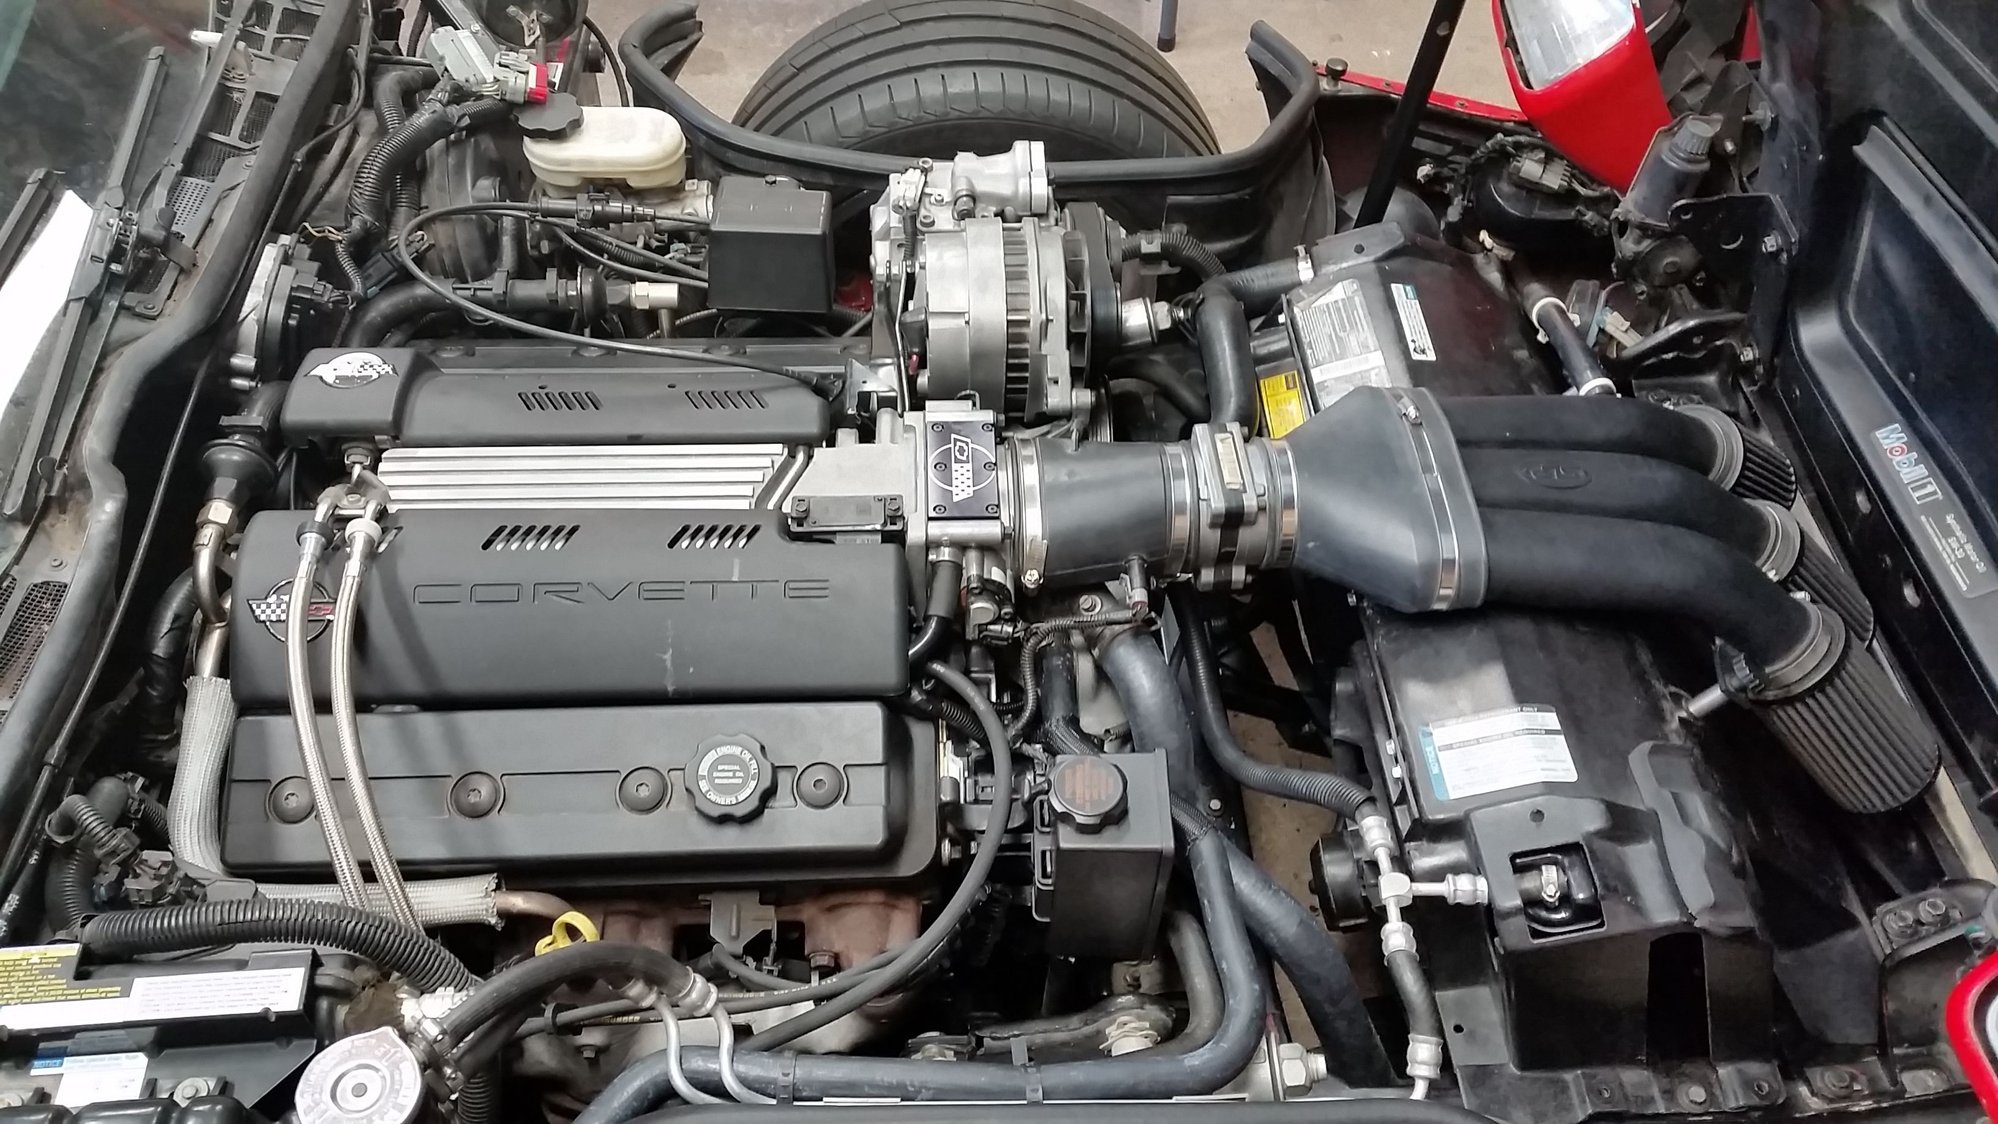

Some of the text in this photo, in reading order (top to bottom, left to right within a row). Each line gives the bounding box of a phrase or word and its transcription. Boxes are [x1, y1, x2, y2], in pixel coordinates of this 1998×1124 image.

[1875, 423, 1929, 484] Mobil
[412, 579, 830, 604] CORVETTE
[716, 745, 759, 775] ENGINE OIL FILL
